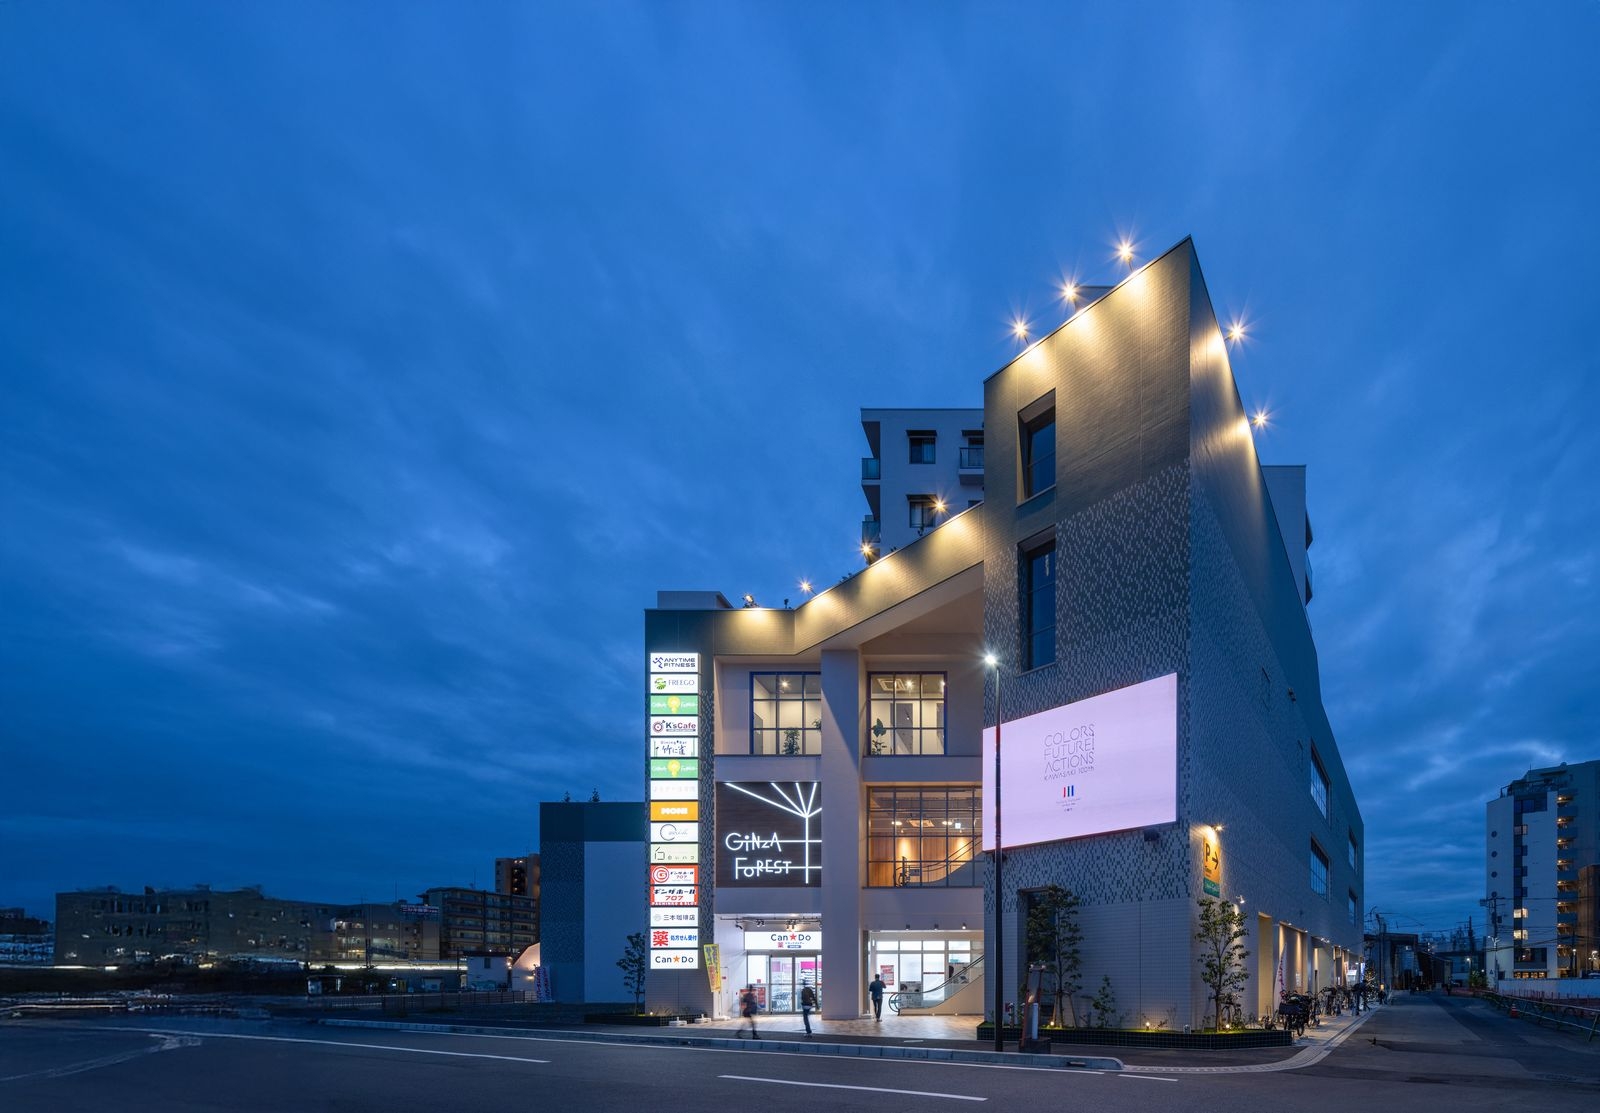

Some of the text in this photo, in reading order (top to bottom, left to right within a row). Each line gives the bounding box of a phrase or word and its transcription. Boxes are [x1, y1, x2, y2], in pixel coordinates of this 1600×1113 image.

[1044, 724, 1095, 747] COLORS
[1044, 752, 1095, 774] ACTIONS
[1044, 769, 1076, 781] KAWASAKI
[1205, 843, 1211, 862] P
[652, 930, 669, 947] 薬
